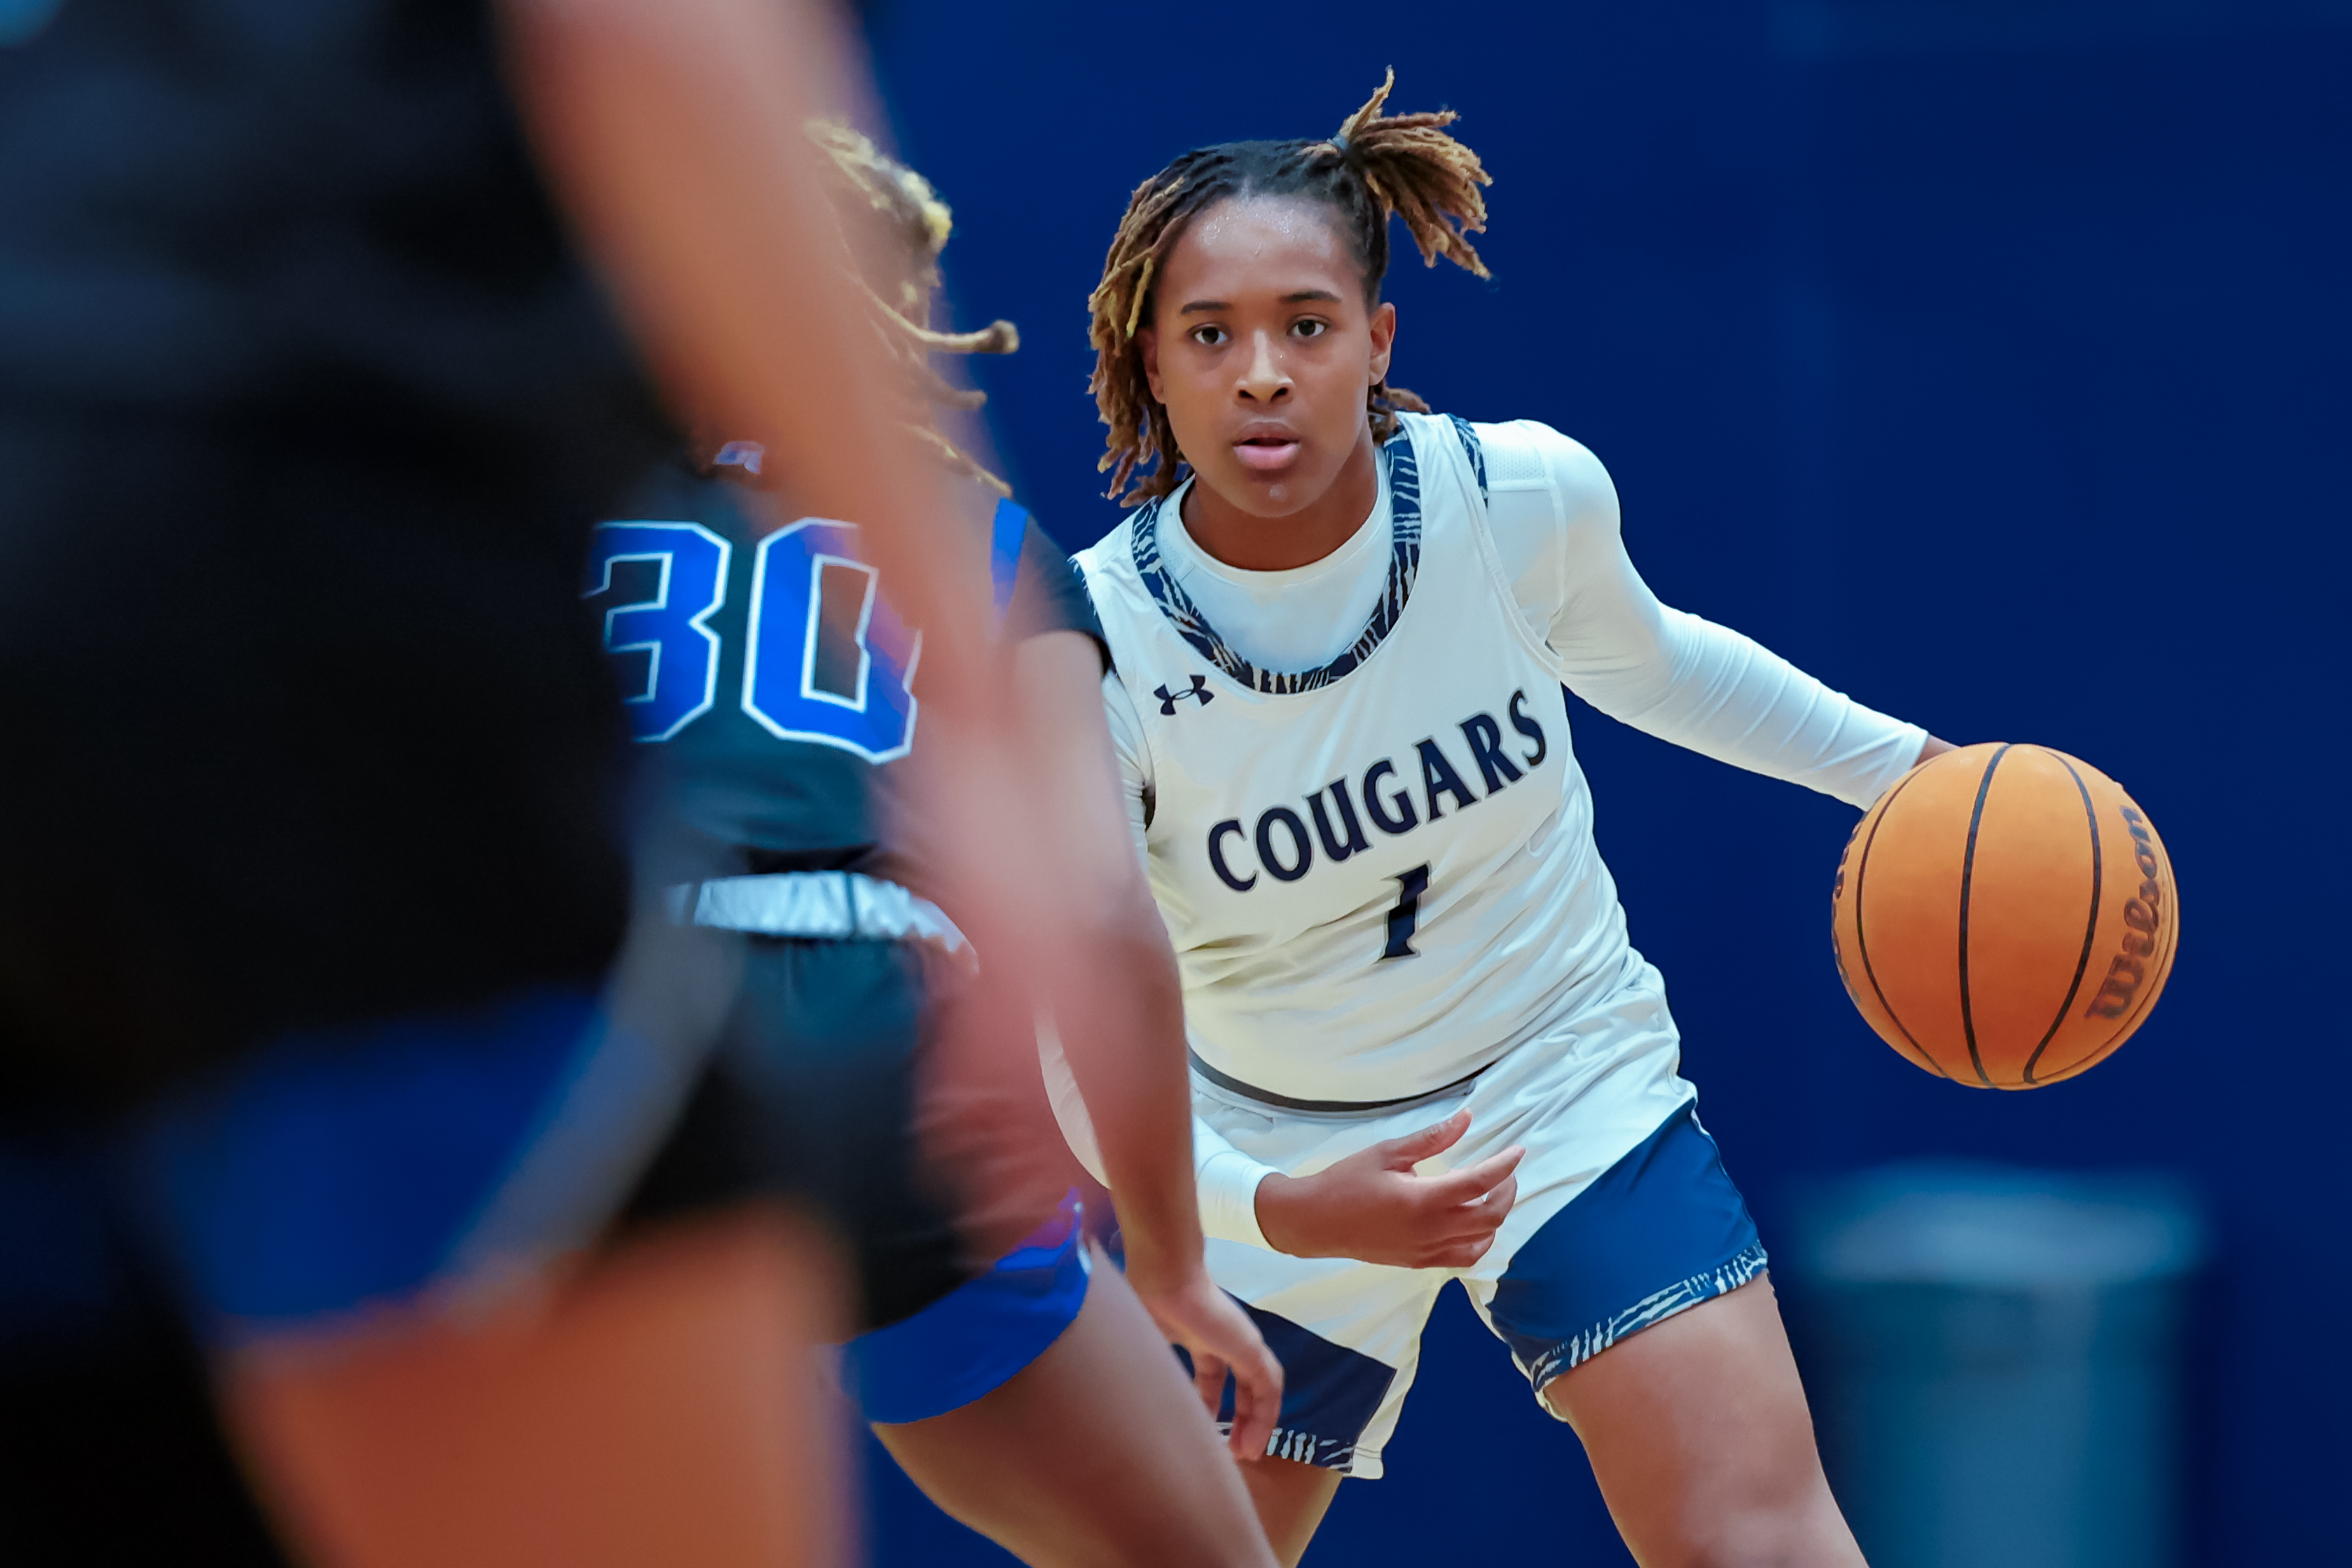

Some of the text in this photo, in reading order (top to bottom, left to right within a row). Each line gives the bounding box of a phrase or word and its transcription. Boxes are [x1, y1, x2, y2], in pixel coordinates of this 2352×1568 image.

[581, 517, 922, 765] 30
[1207, 686, 1548, 893] COUGARS
[1377, 859, 1432, 962] 1
[2083, 804, 2160, 1020] Wilson
